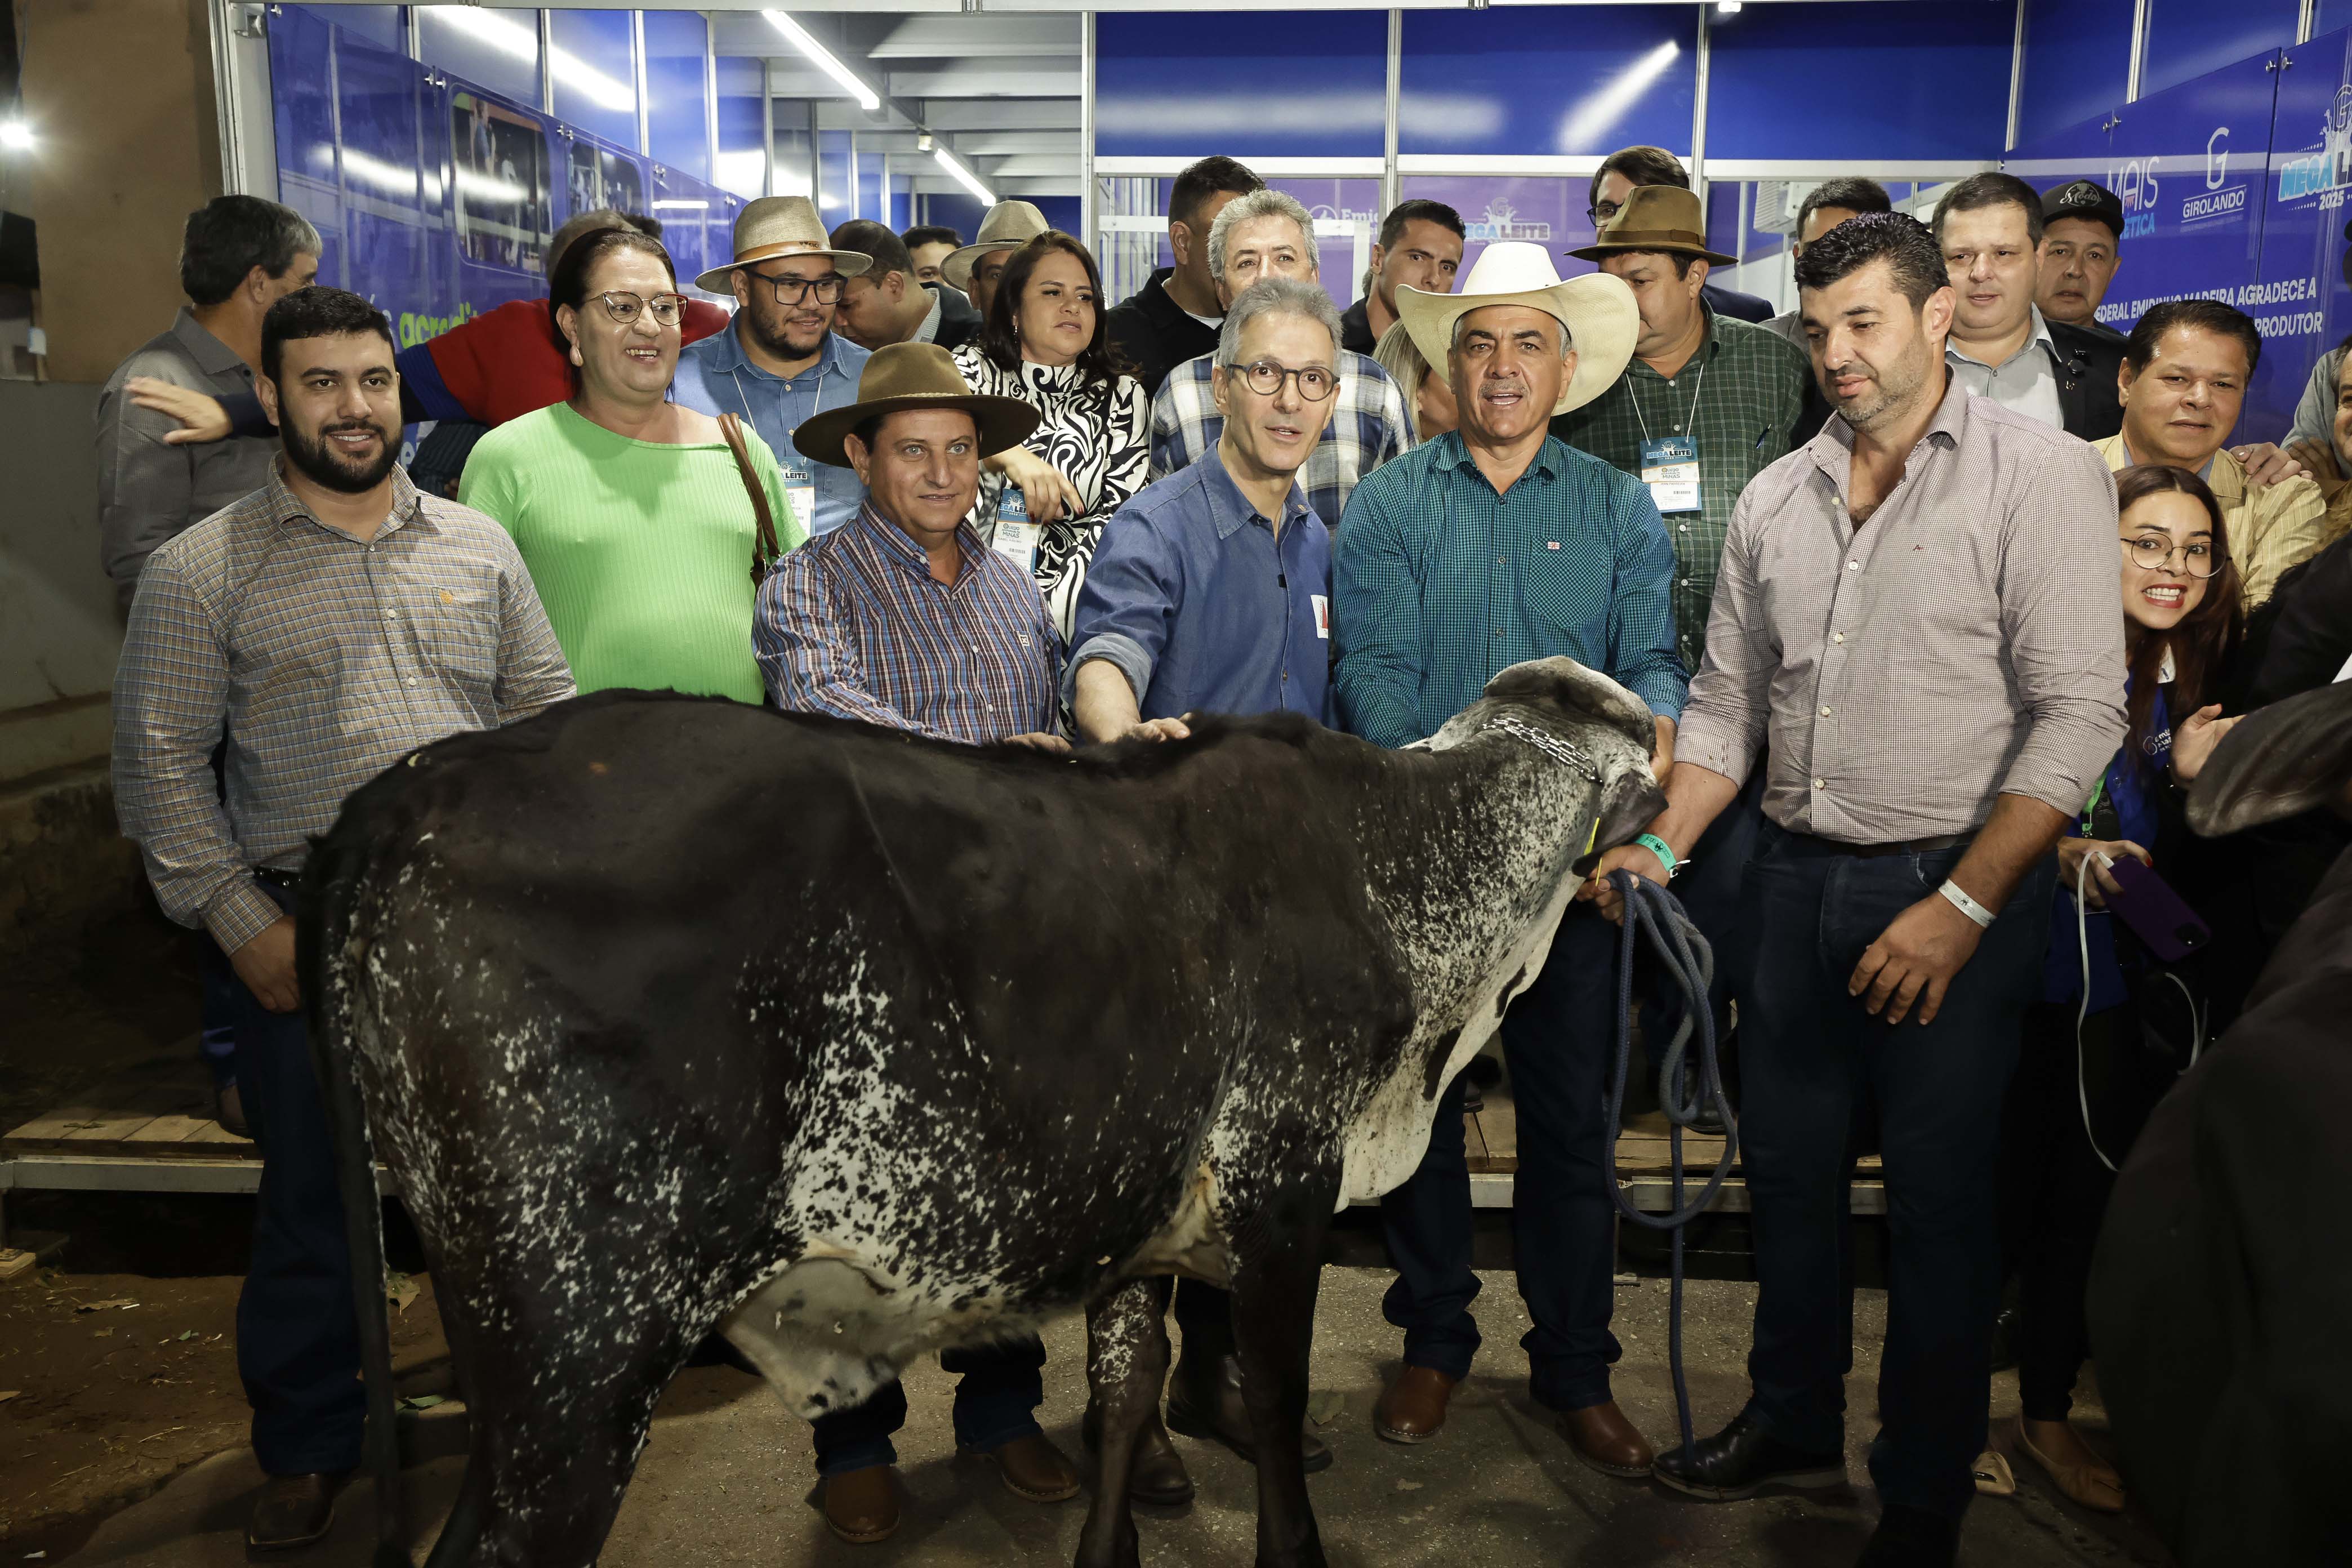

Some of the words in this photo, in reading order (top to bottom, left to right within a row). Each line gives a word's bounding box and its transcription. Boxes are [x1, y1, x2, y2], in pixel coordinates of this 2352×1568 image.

[2106, 156, 2159, 214] MAIS
[2183, 190, 2244, 218] GIROLANDO
[2319, 191, 2344, 210] 2025
[2120, 212, 2155, 239] ÉTICA
[2094, 302, 2129, 323] EDERAL
[2236, 278, 2306, 306] AGRADECE
[2307, 277, 2317, 299] A
[2254, 311, 2323, 338] PRODUTOR
